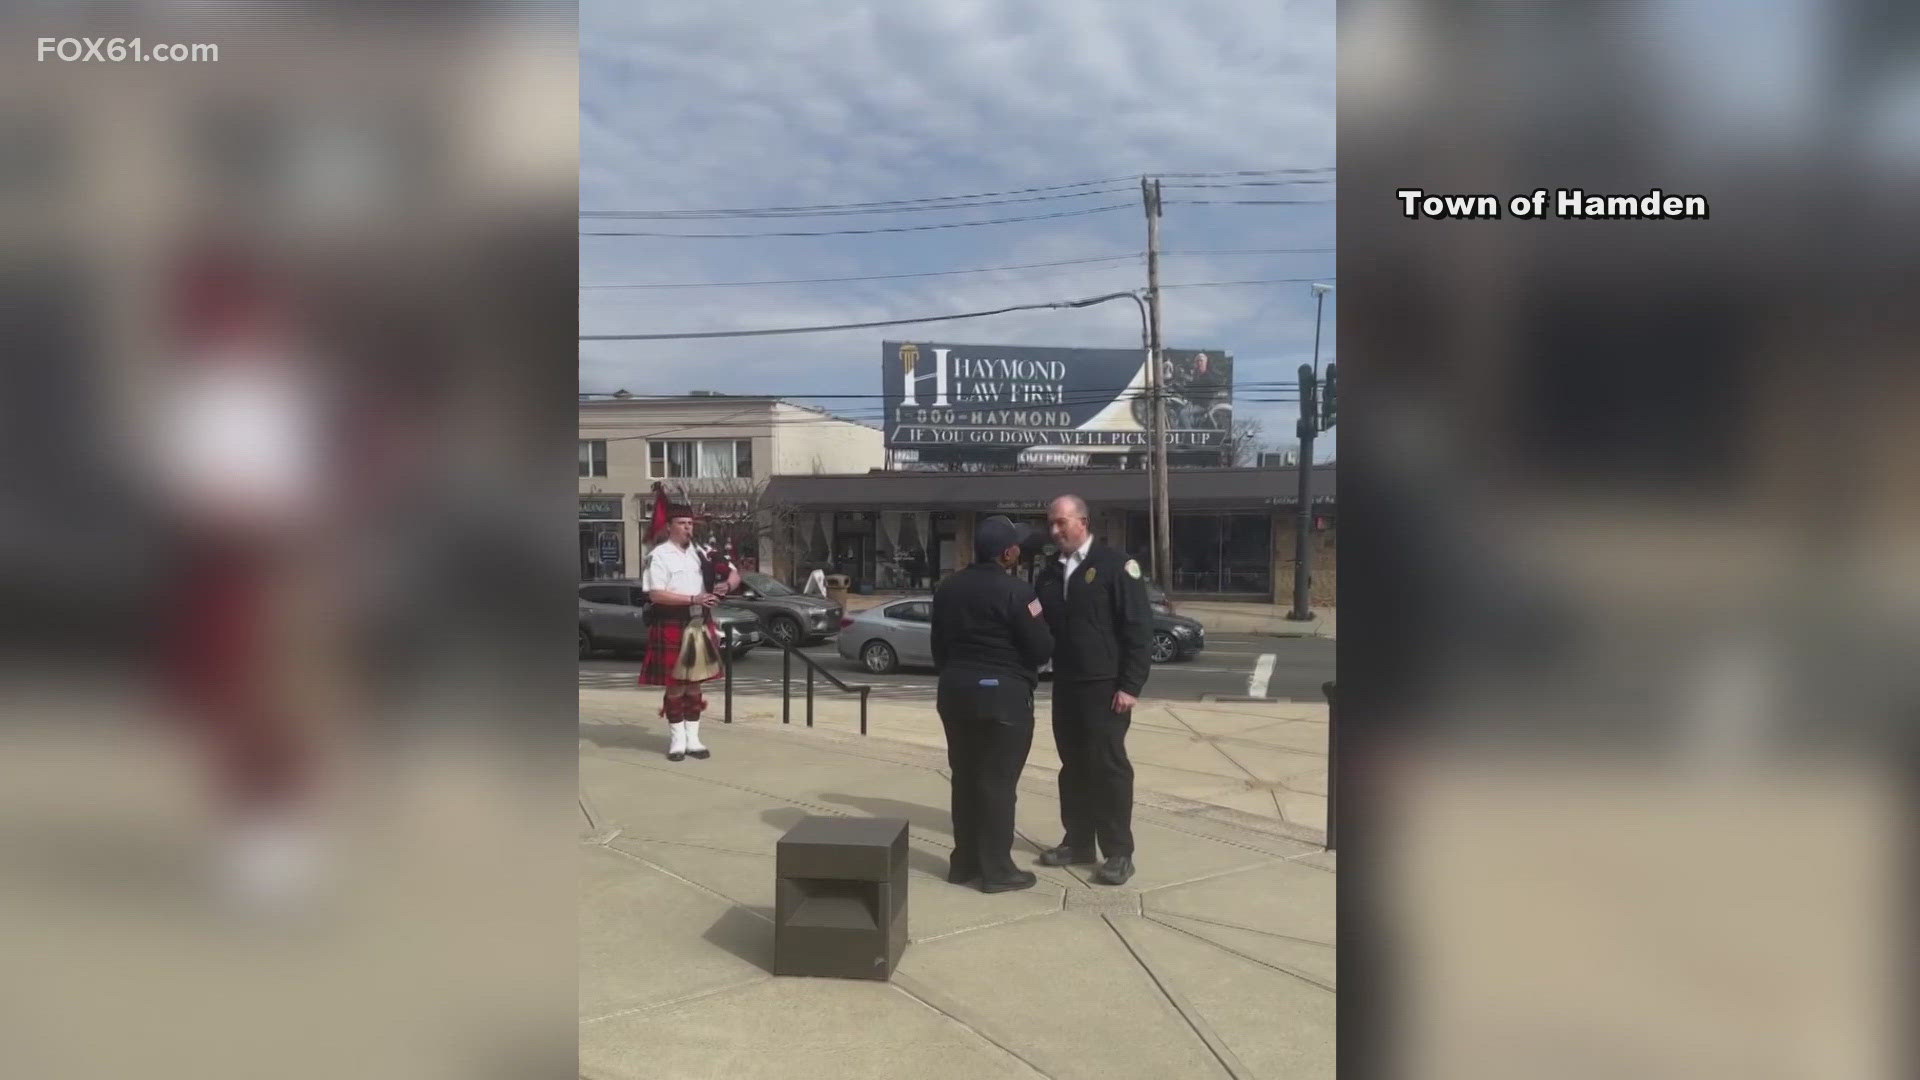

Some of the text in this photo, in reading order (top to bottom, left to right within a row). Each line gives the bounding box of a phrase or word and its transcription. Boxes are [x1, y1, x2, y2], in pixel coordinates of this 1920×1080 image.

[954, 357, 1066, 381] HAYMOND
[955, 382, 1064, 404] LAW FIRM
[910, 429, 925, 442] IF
[932, 429, 964, 443] YOU
[970, 431, 994, 443] GO
[1111, 432, 1147, 445] PICK
[1160, 432, 1186, 445] OU
[1191, 432, 1210, 445] UP
